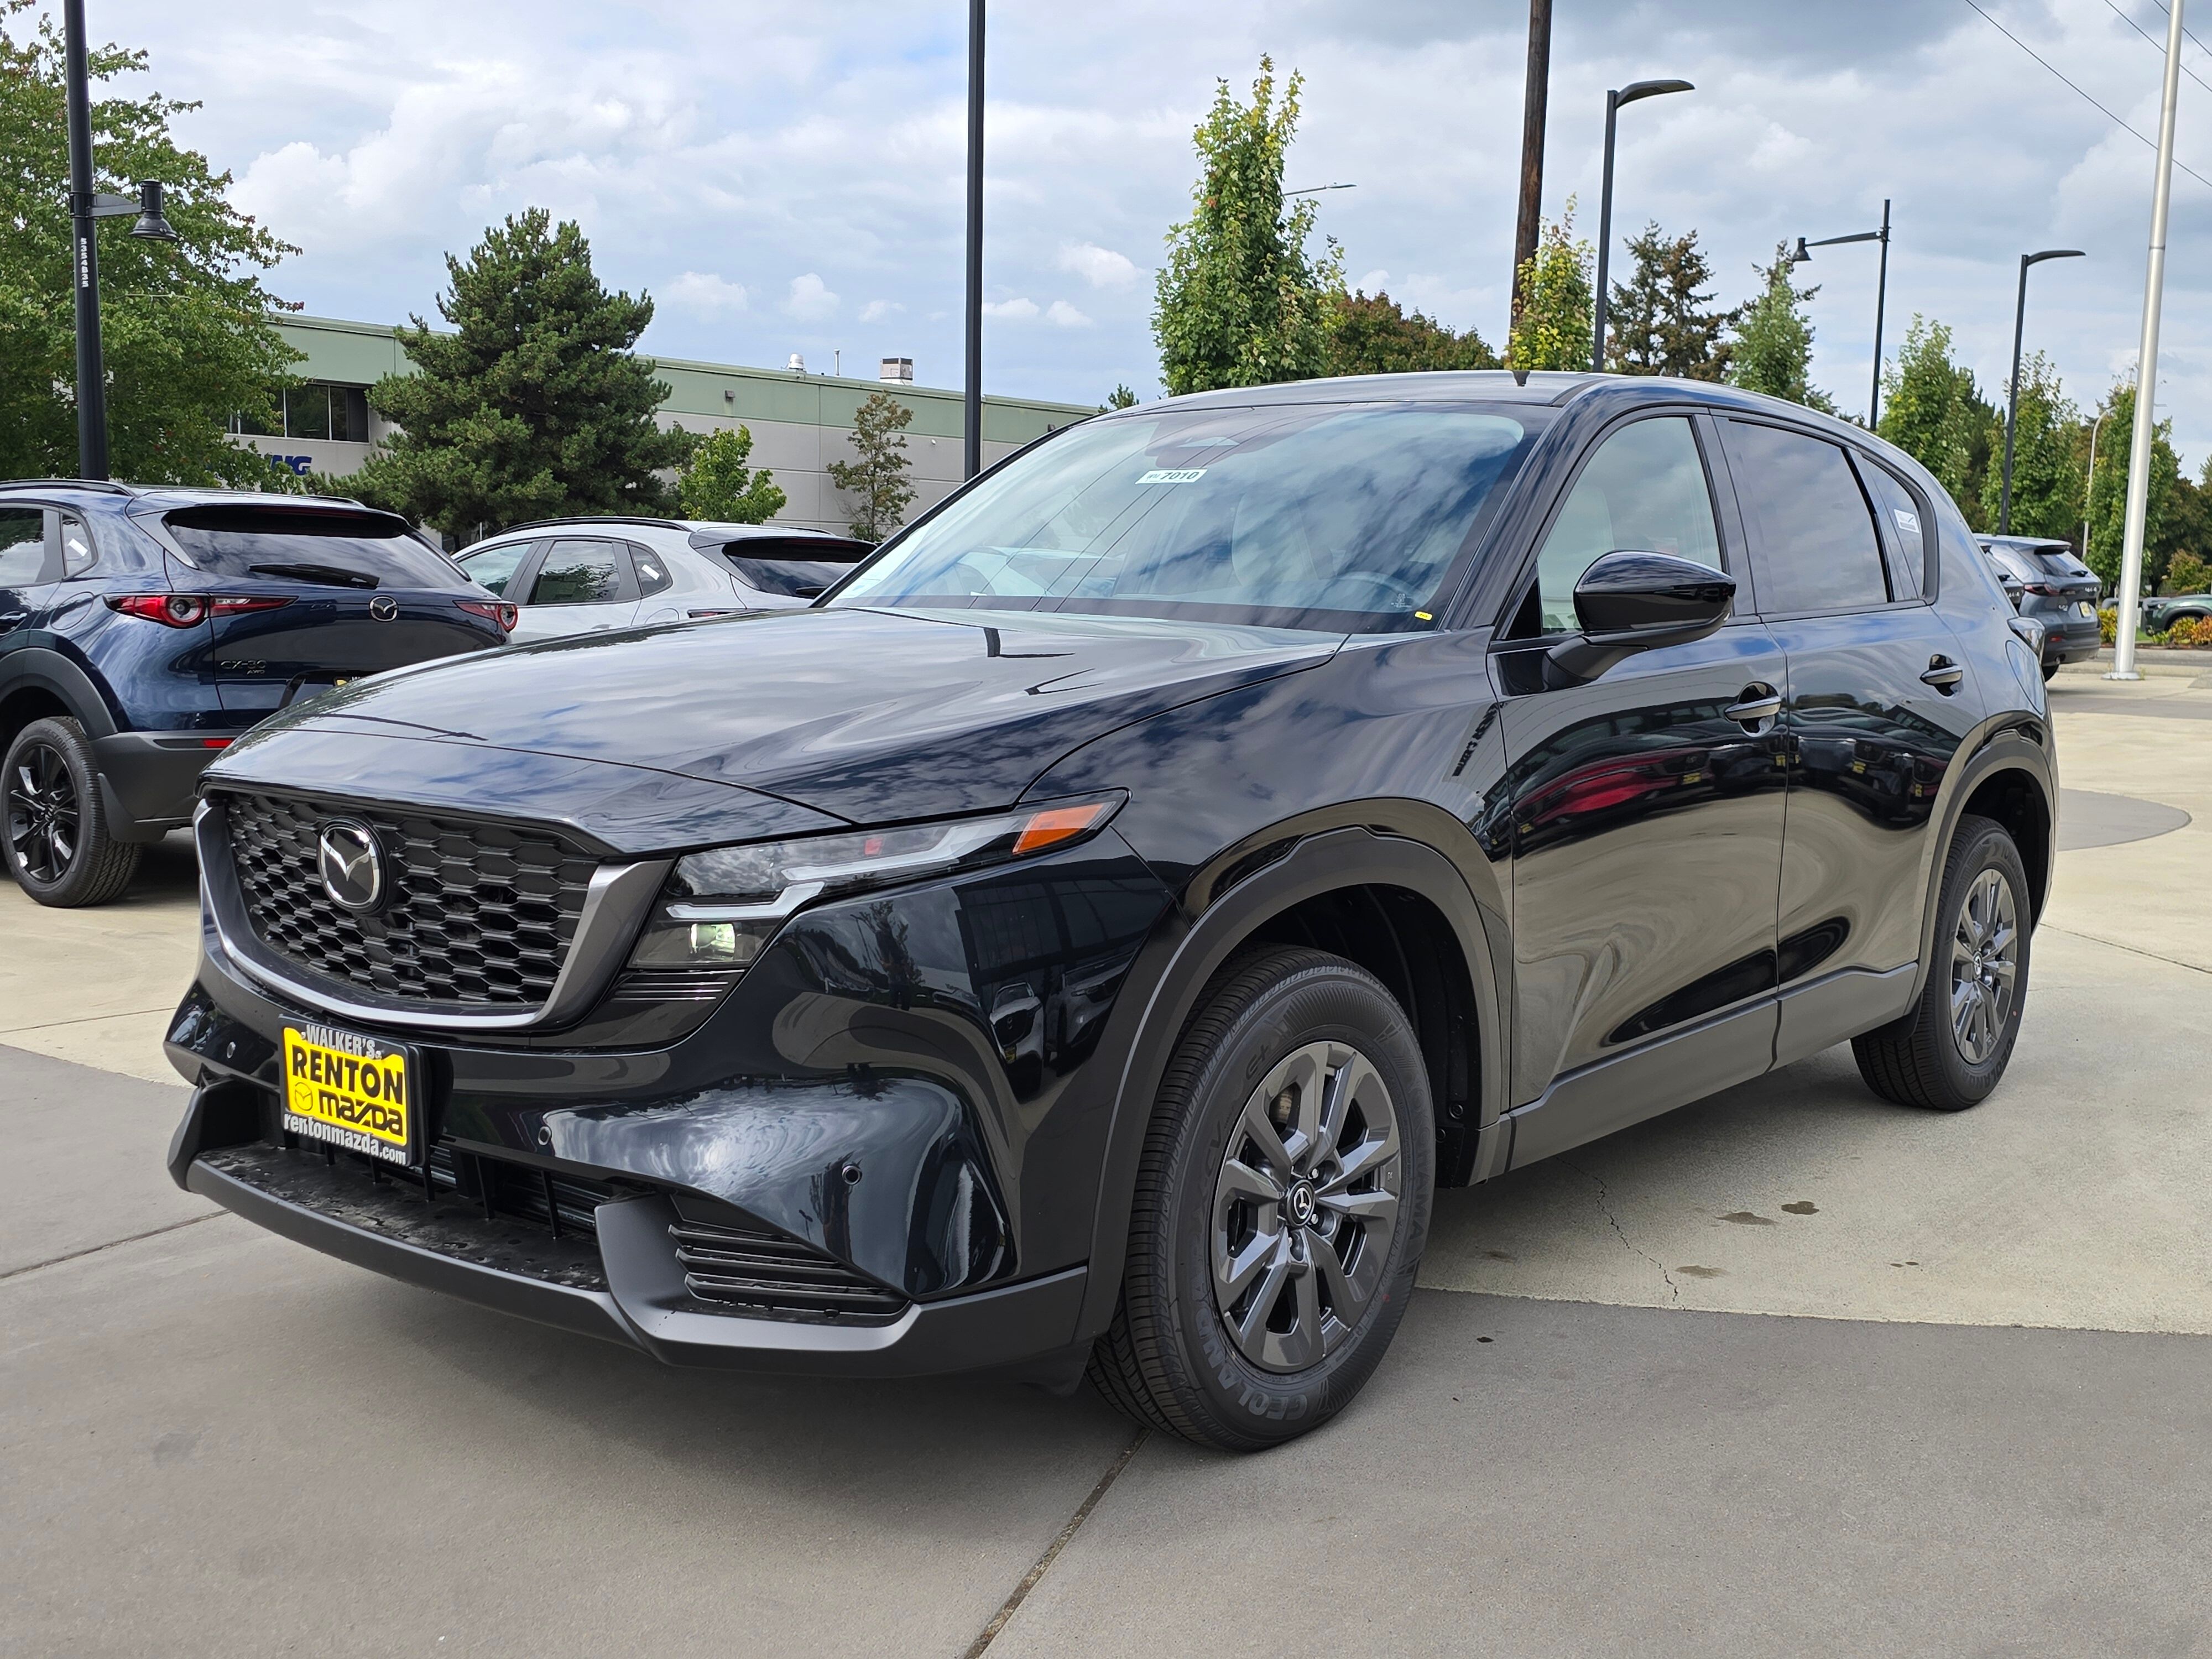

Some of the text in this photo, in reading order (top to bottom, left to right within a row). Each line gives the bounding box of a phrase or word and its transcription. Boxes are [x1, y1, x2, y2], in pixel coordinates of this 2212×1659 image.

[221, 660, 267, 669] CX-30
[306, 1024, 376, 1060] WALKER'S
[292, 1045, 403, 1105] RENTON
[284, 1113, 406, 1165] rentonmazda.com
